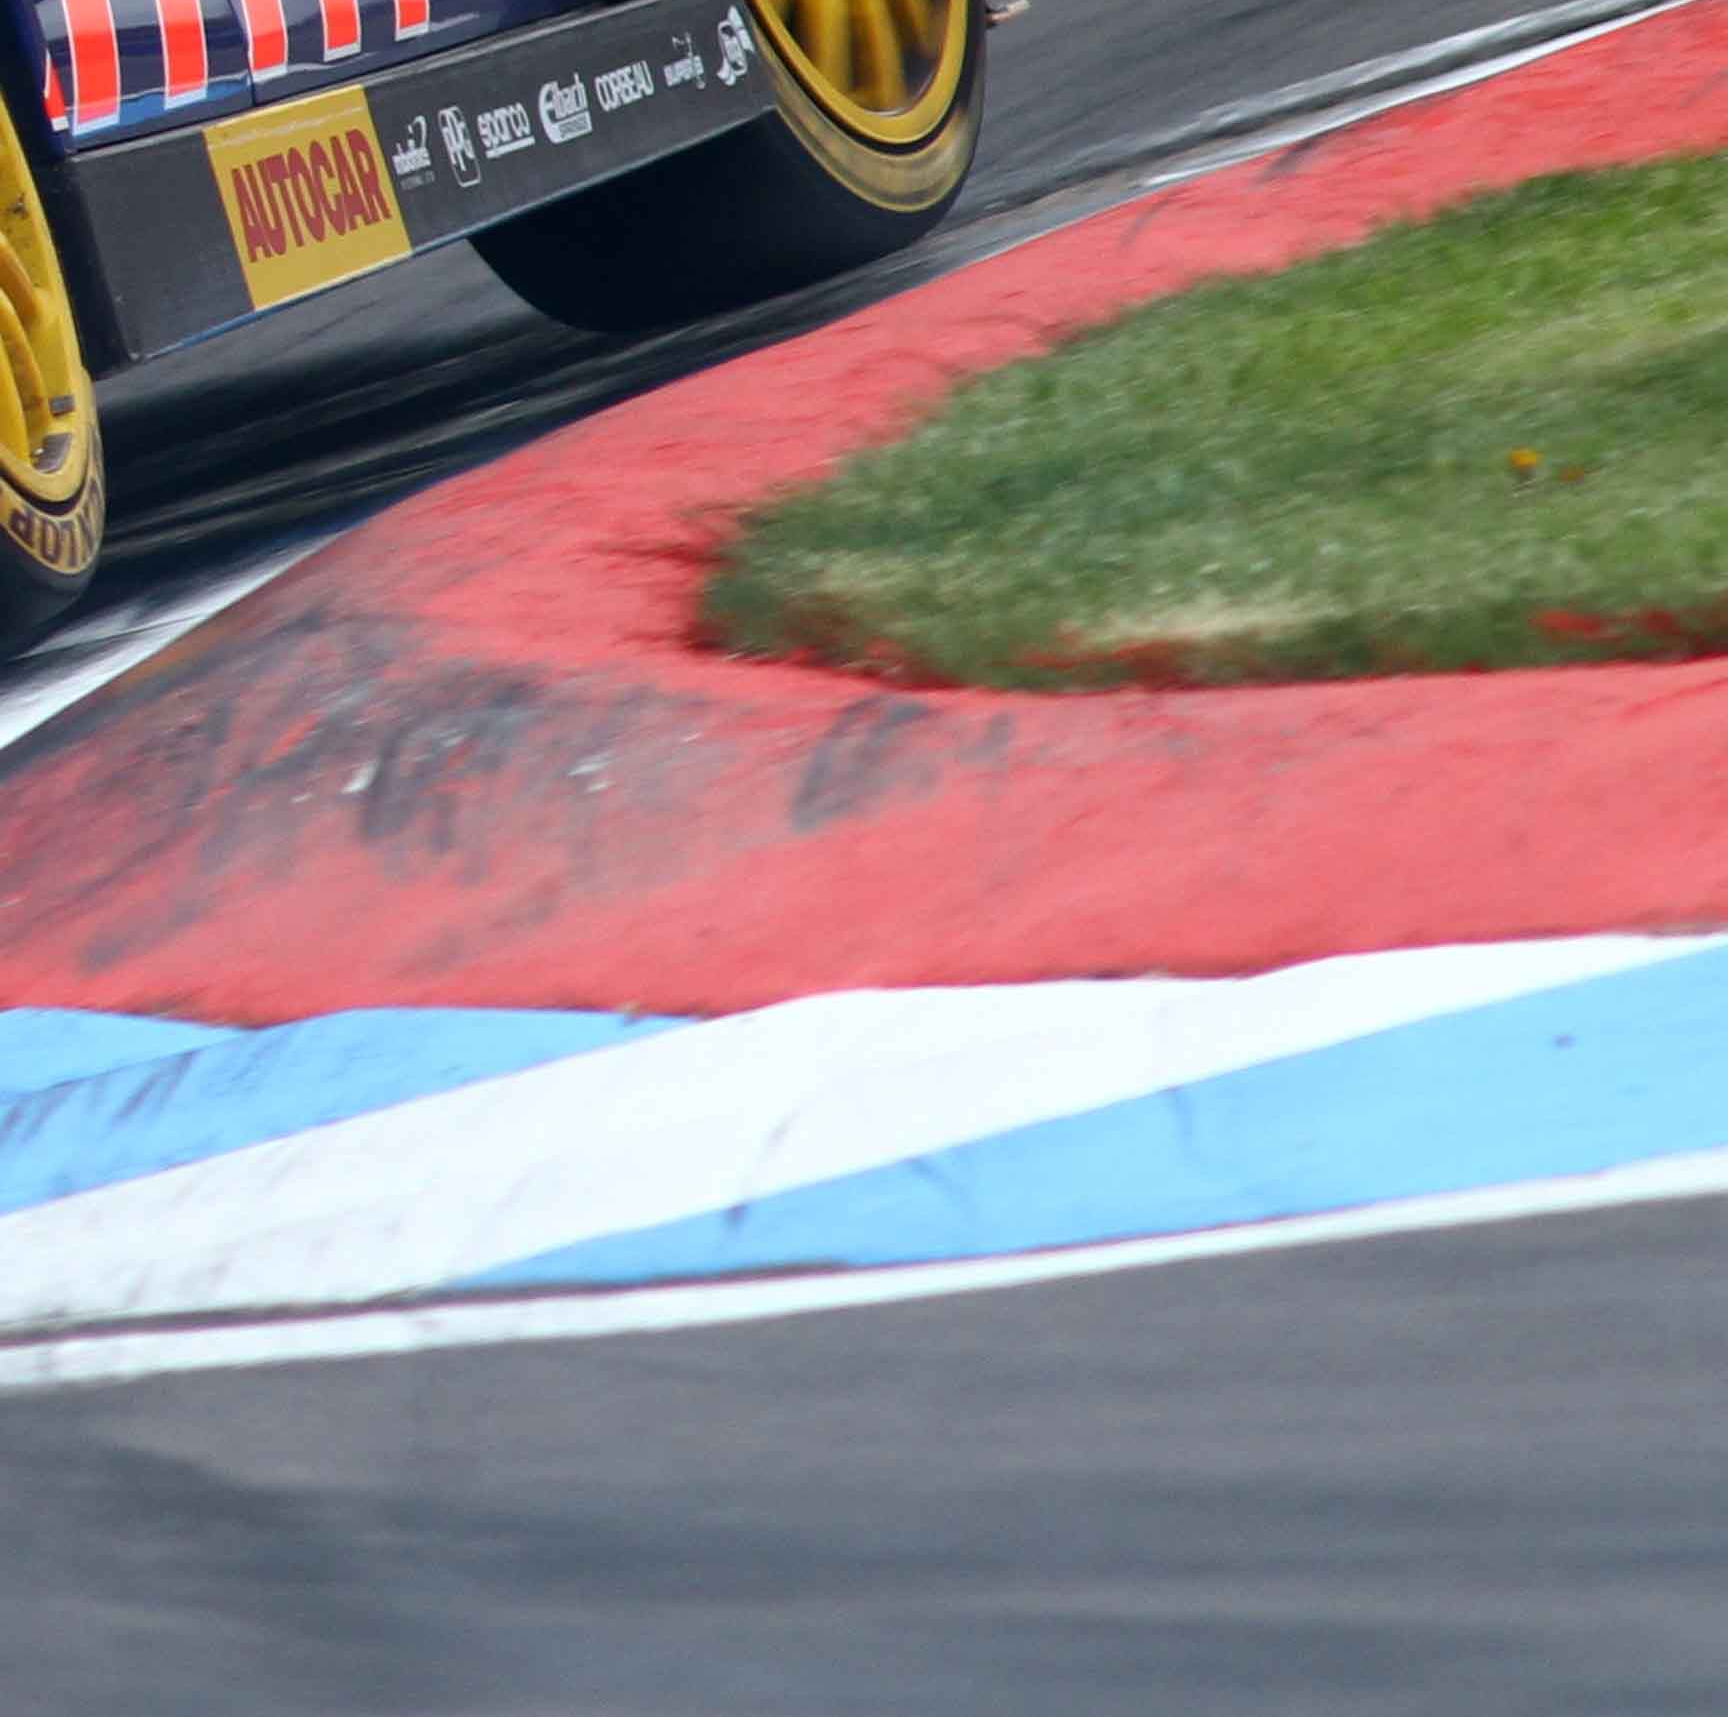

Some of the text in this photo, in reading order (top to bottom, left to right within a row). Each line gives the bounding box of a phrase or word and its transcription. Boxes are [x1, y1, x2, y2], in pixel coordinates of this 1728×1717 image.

[594, 60, 655, 112] CORBEAU
[477, 102, 531, 151] sparco
[231, 128, 393, 264] AUTOCAR
